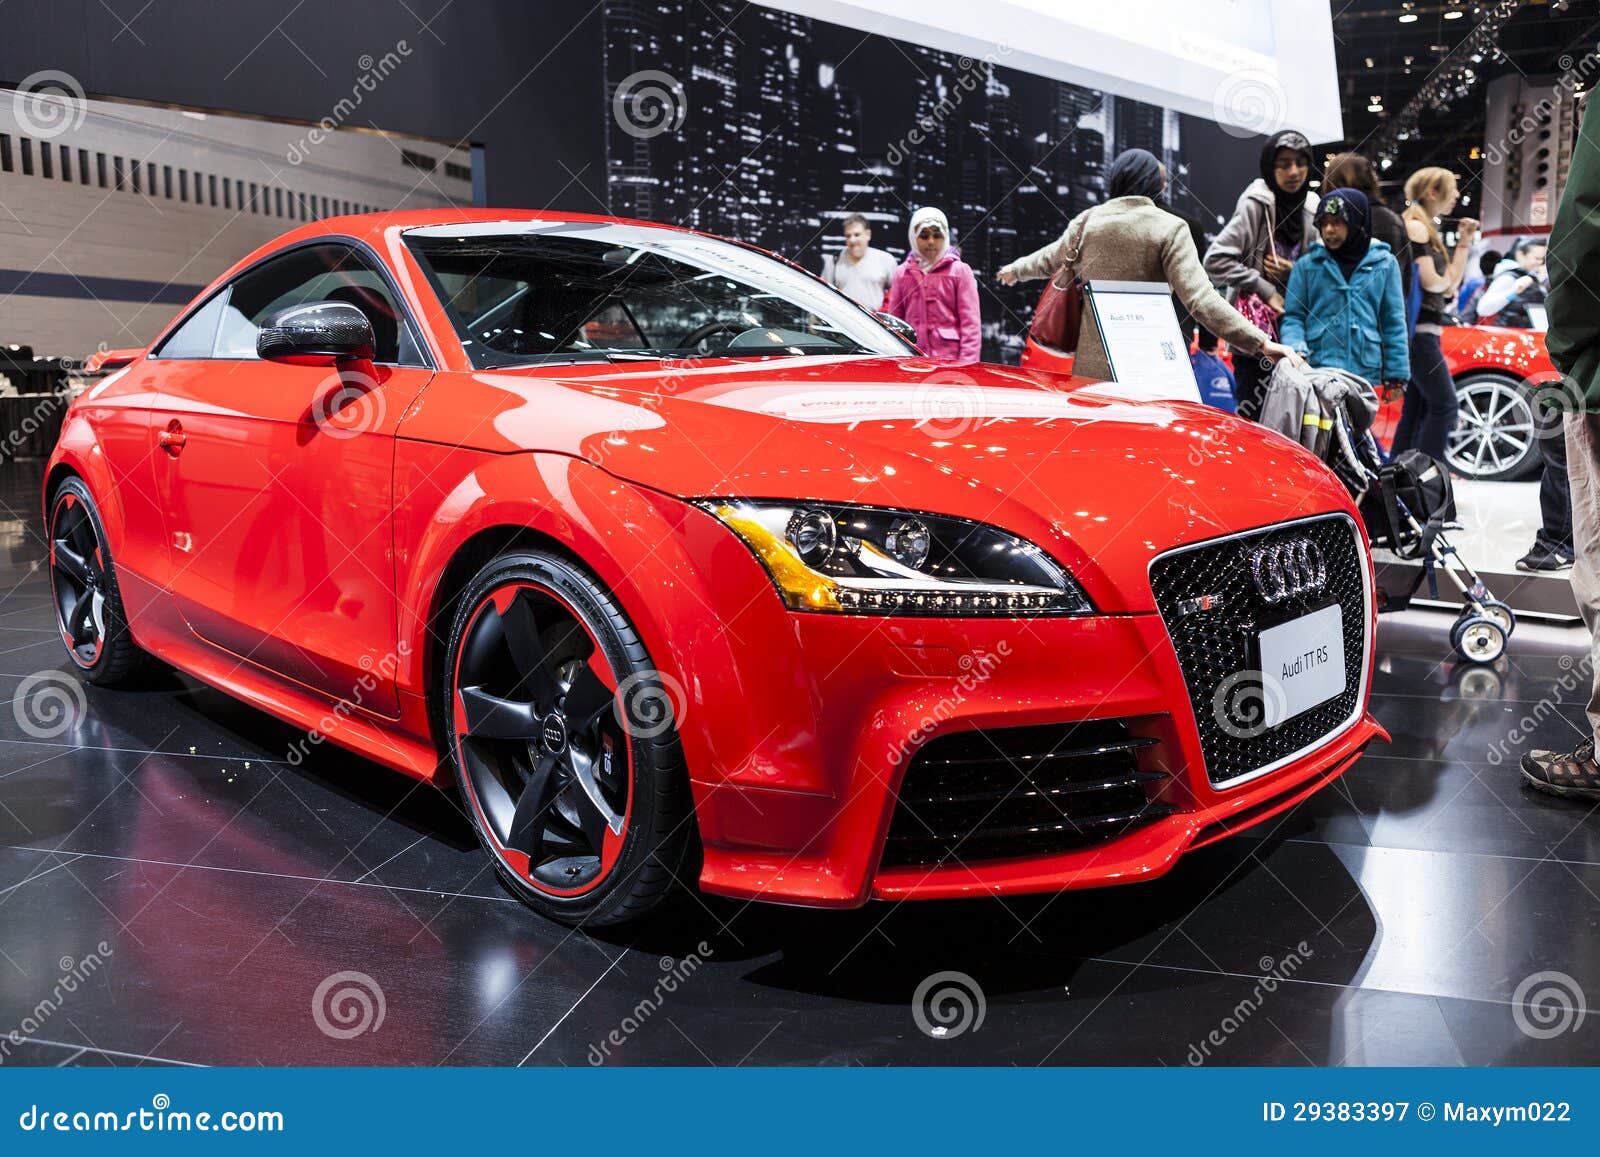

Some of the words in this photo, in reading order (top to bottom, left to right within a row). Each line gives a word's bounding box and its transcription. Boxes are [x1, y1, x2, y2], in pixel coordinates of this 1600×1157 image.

[1281, 656, 1303, 681] Audi
[1303, 650, 1315, 670] TT
[1316, 645, 1329, 665] RS
